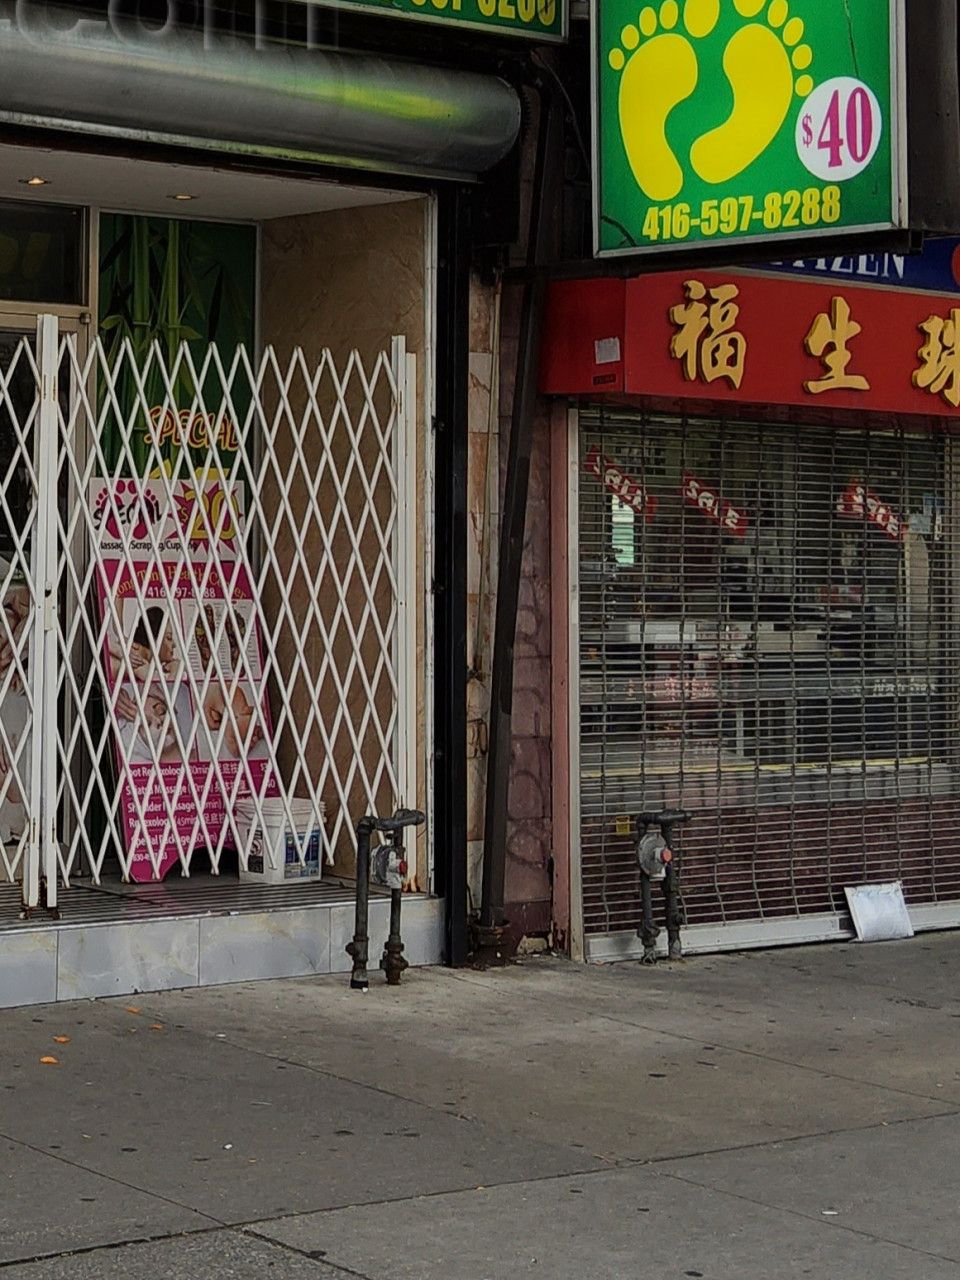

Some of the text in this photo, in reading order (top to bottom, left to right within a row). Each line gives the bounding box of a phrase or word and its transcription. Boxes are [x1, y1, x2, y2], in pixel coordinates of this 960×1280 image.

[801, 86, 873, 169] $40
[642, 184, 841, 241] 416-597-8288
[114, 578, 134, 597] ong
[167, 565, 204, 582] Heath
